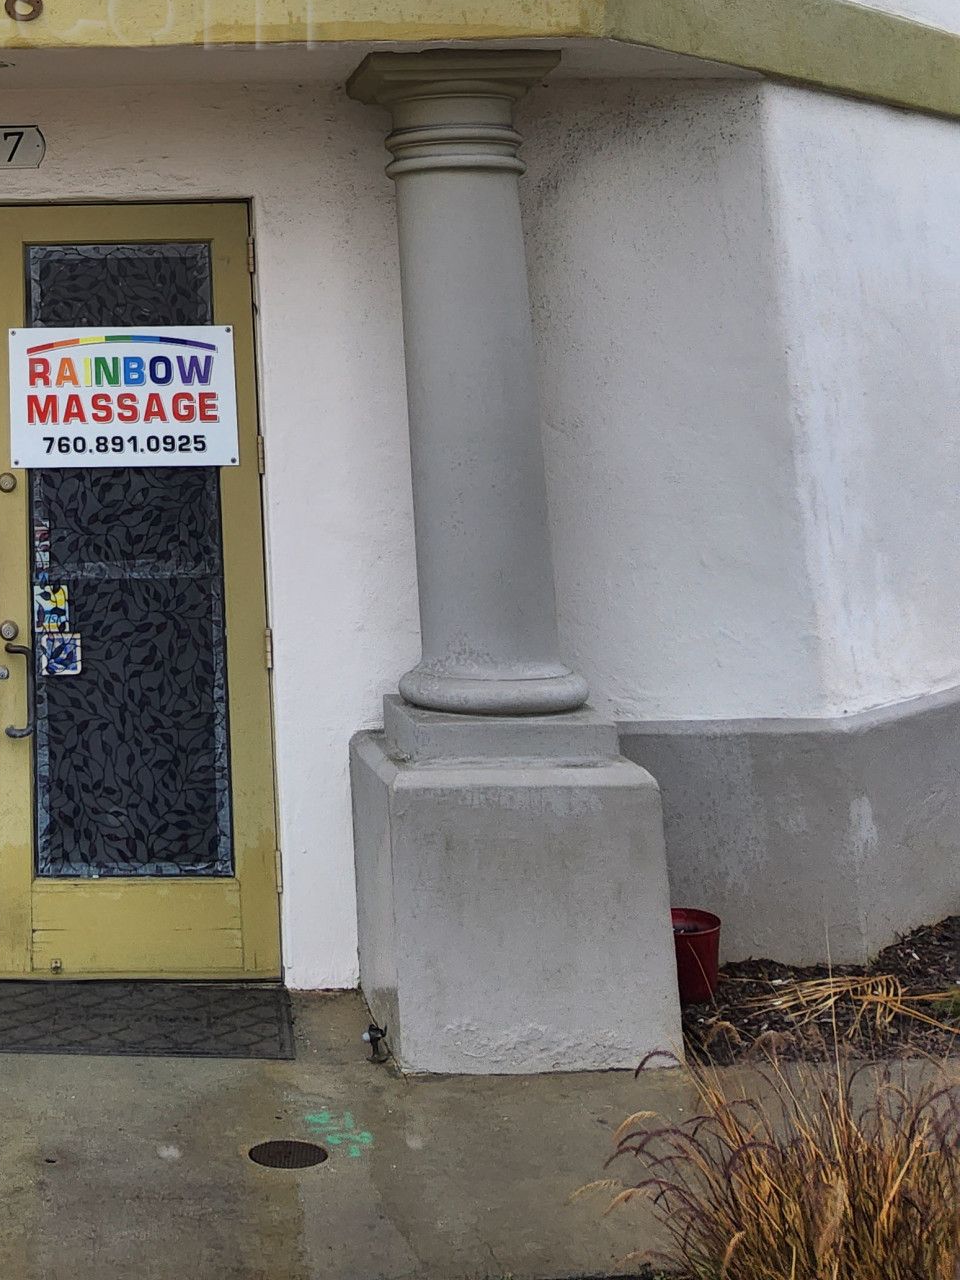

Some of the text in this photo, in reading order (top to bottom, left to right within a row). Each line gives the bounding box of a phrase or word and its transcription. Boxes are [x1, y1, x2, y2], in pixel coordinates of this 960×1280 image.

[28, 355, 213, 387] RAINBOW
[26, 391, 220, 424] MASSAGE
[42, 434, 207, 454] 760.891.0925
